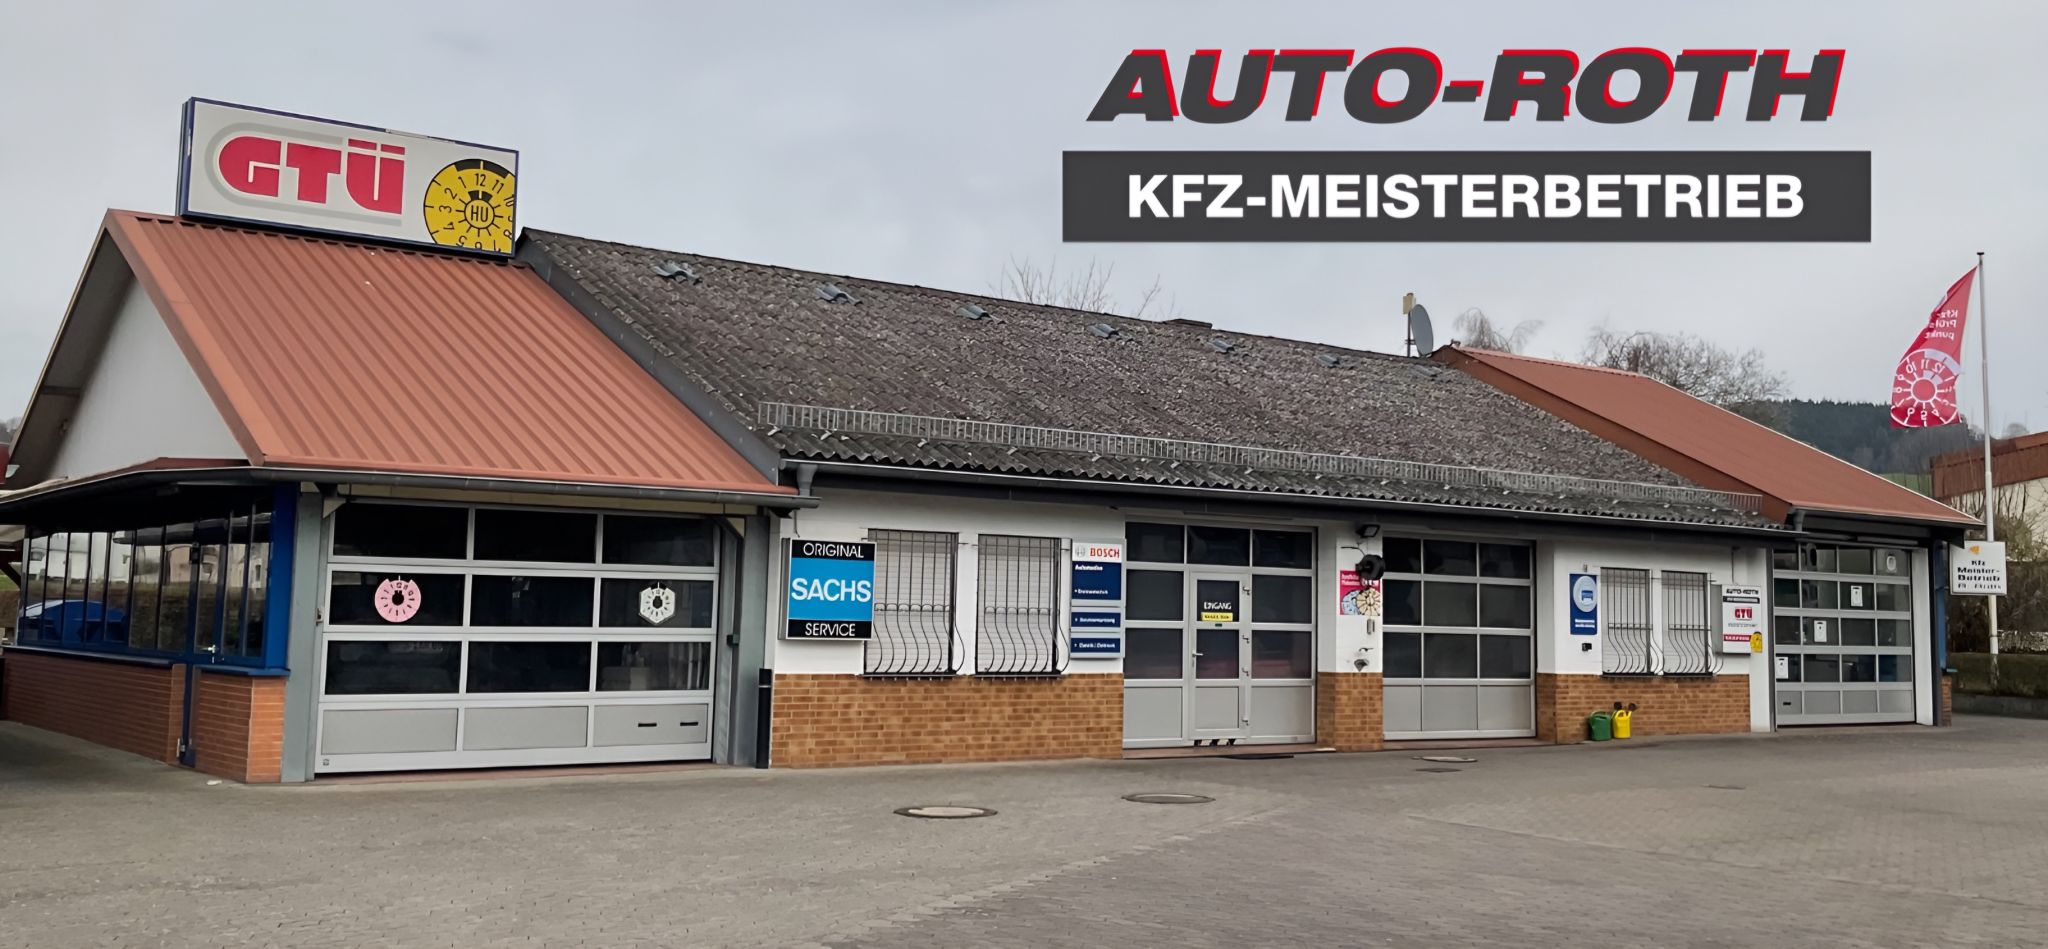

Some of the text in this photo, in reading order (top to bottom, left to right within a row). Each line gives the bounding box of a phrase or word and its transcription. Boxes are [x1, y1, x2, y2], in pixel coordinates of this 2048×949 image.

[218, 136, 405, 215] GTÜ
[475, 173, 486, 187] 12
[444, 187, 457, 200] 2
[492, 179, 504, 194] 11
[438, 205, 452, 213] 3
[471, 205, 489, 222] HU
[803, 542, 864, 558] ORIGINAL
[1090, 547, 1120, 558] BOSCH
[791, 578, 871, 602] SACHS
[804, 622, 856, 637] SERVICE
